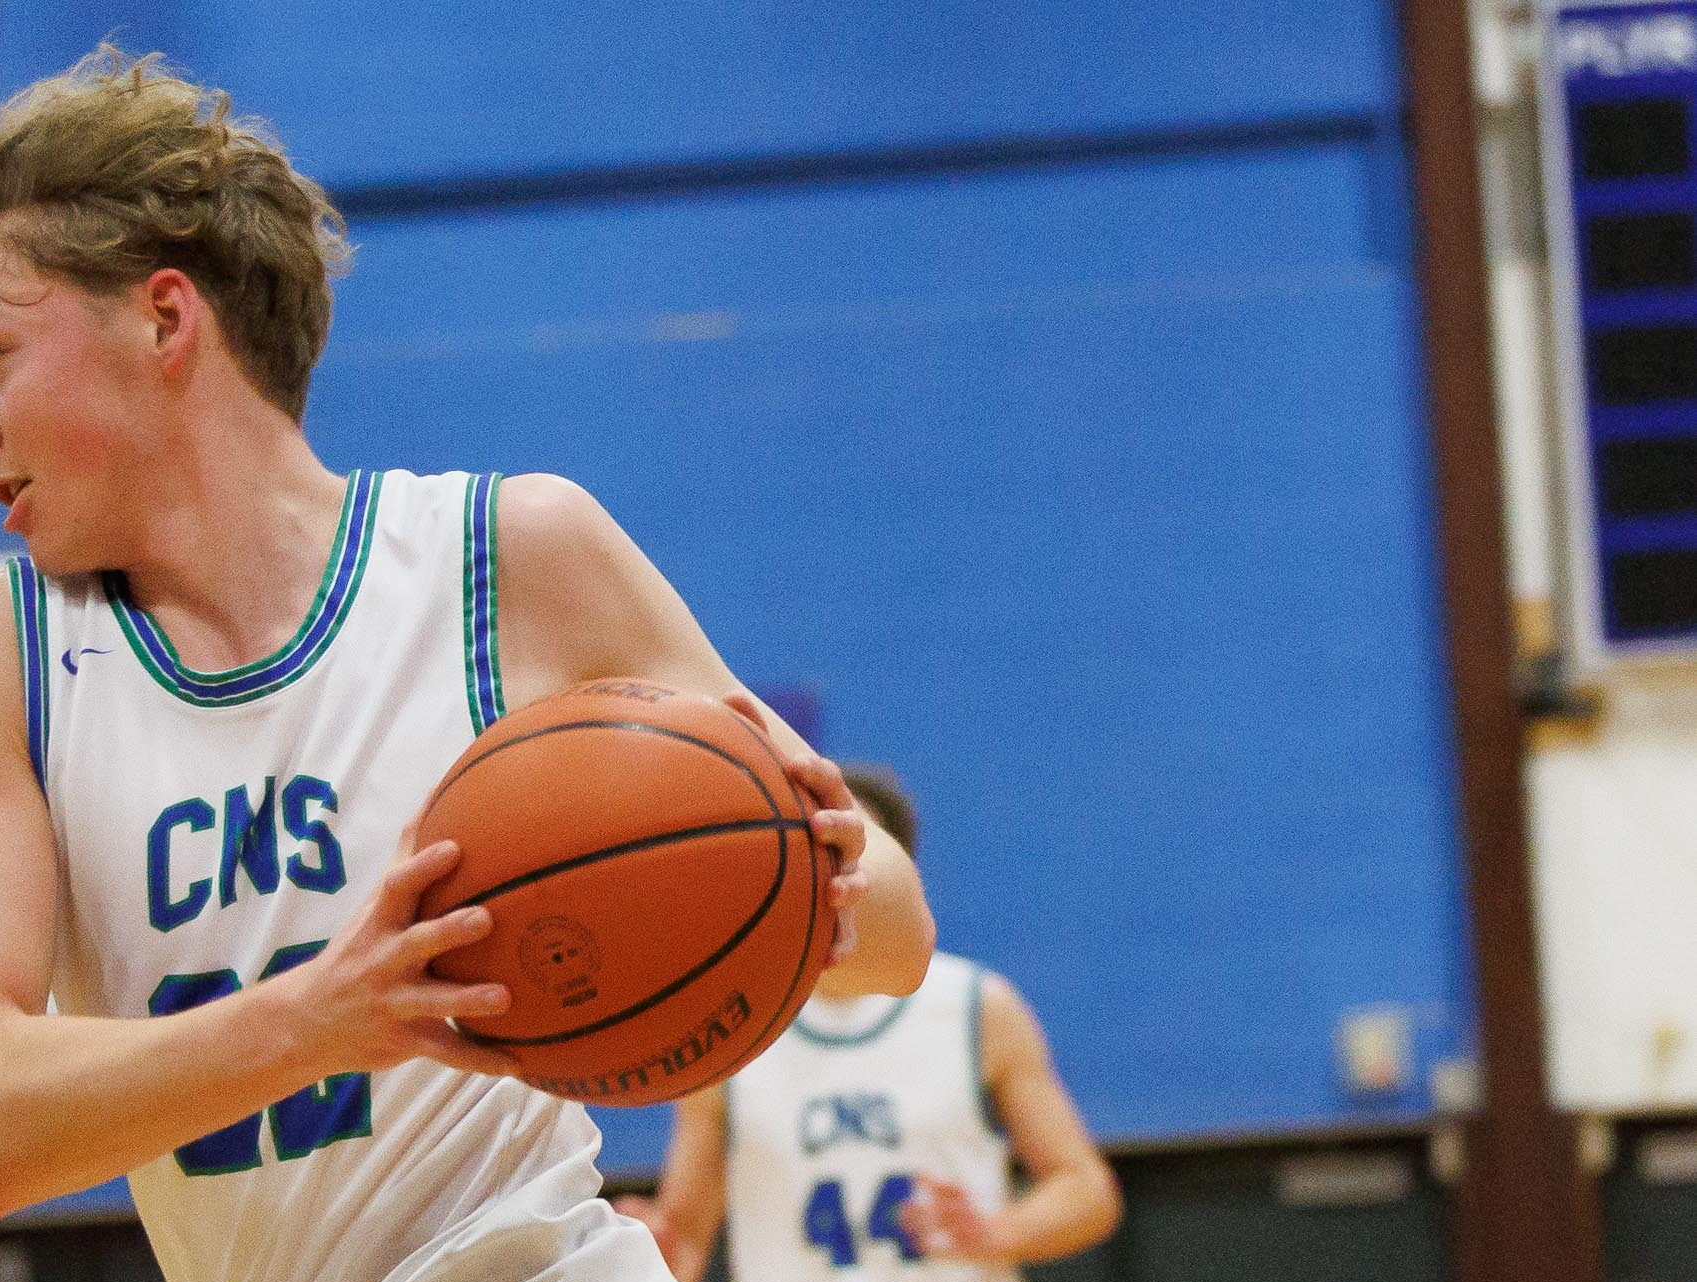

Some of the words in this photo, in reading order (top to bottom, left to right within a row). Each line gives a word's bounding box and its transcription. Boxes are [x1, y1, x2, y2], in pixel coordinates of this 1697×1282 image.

[147, 774, 347, 934] CNS
[802, 1090, 901, 1156] CNS
[804, 1173, 924, 1269] 44
